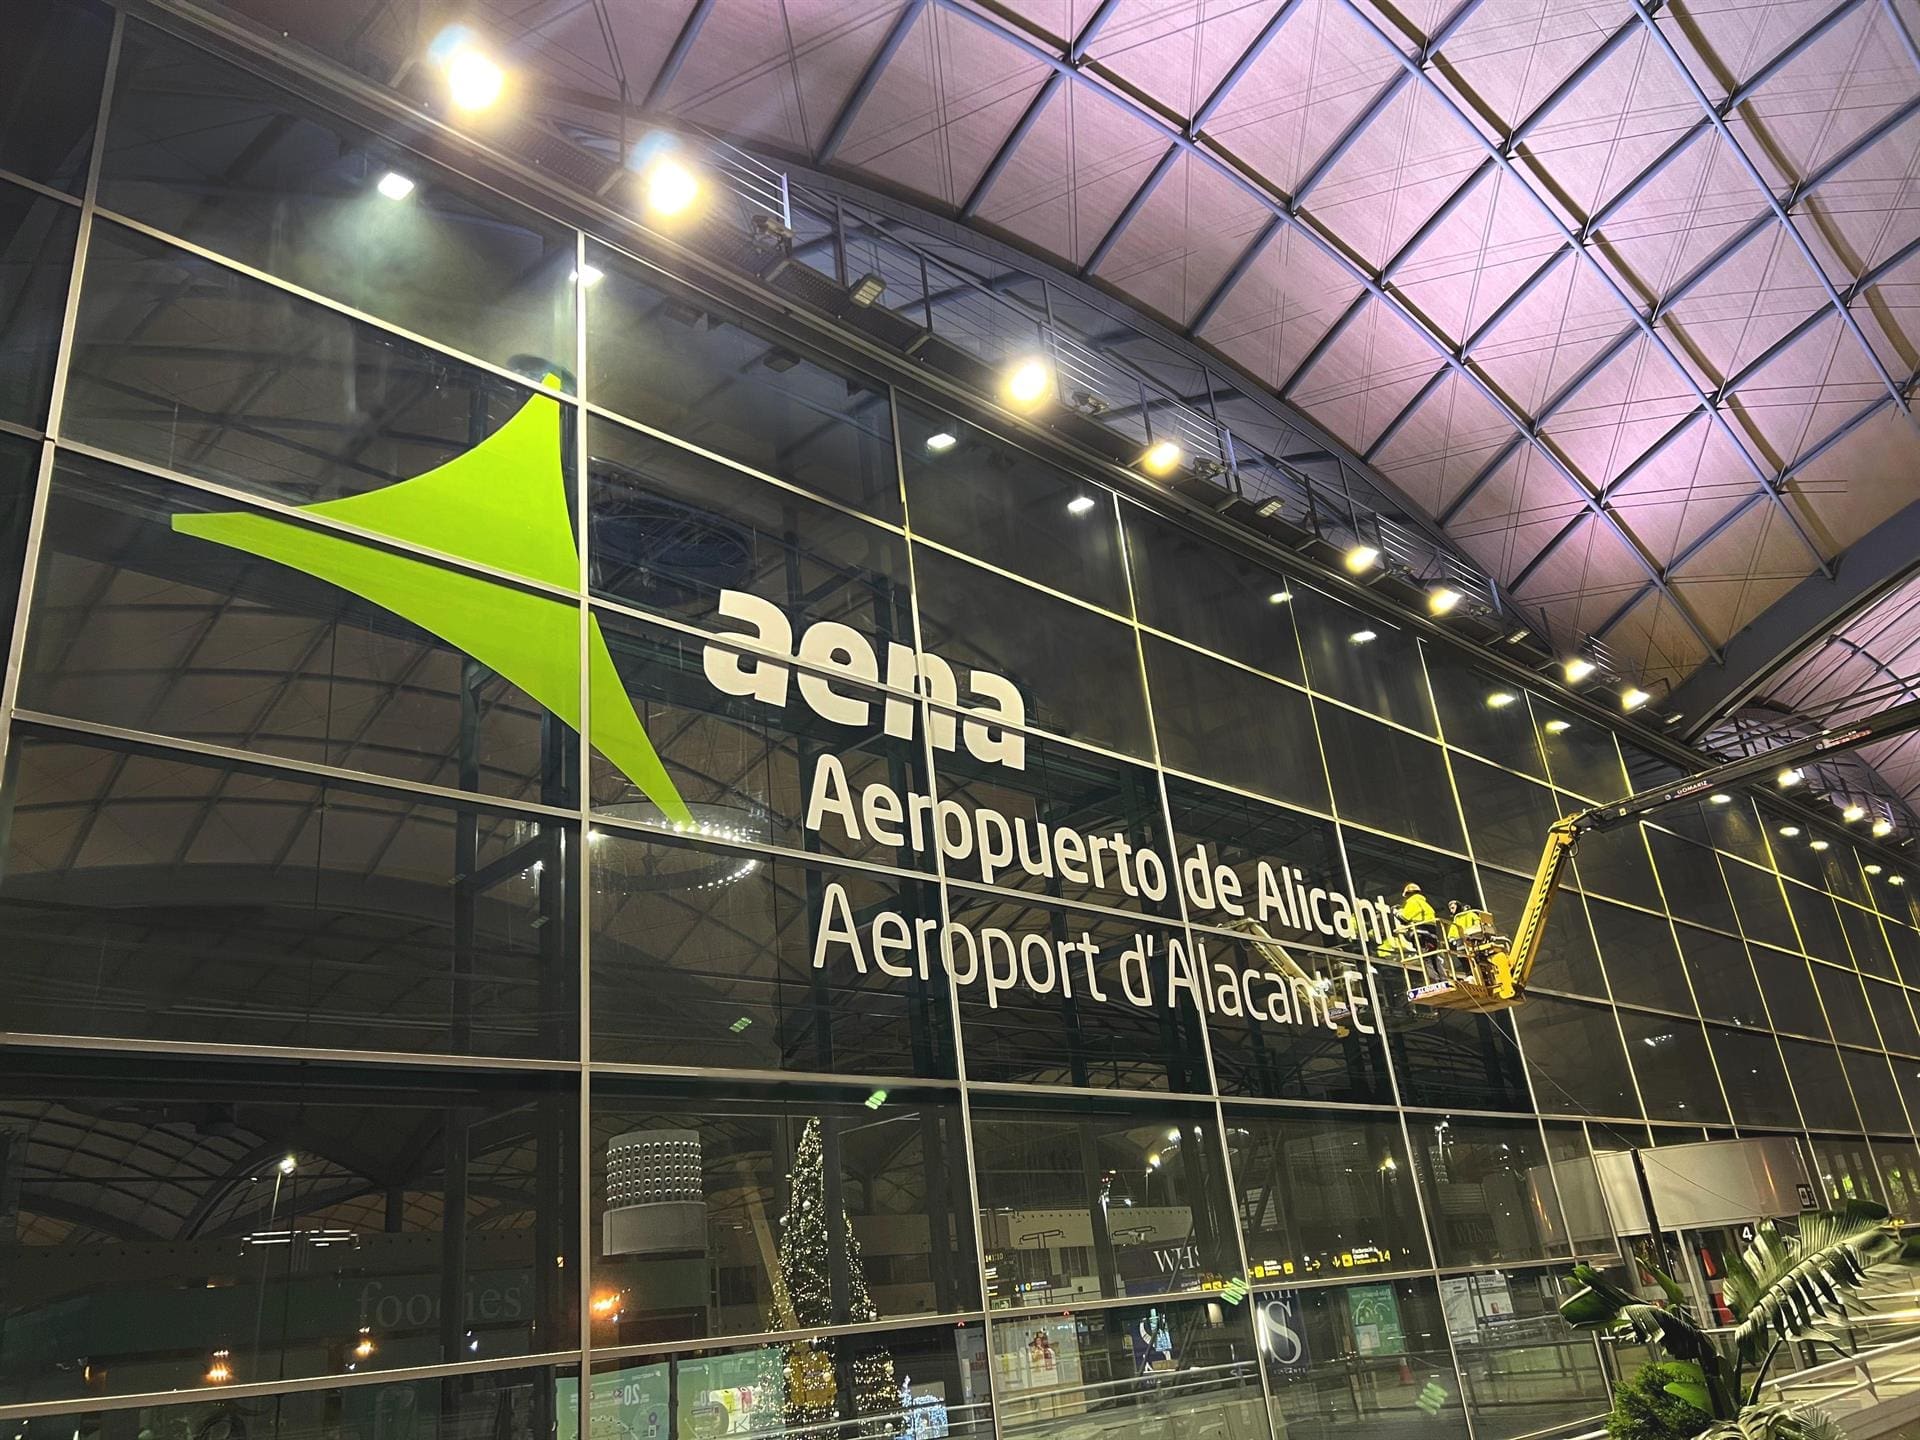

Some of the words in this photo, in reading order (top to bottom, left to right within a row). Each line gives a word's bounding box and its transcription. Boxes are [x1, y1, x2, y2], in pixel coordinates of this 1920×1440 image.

[703, 589, 1026, 771] aena
[806, 753, 1168, 901] Aeropuerto
[1184, 844, 1244, 916] de
[813, 883, 1107, 1008] Aeroport
[1379, 1249, 1391, 1263] 14
[1742, 1226, 1753, 1240] 4
[357, 1274, 529, 1329] fooies'
